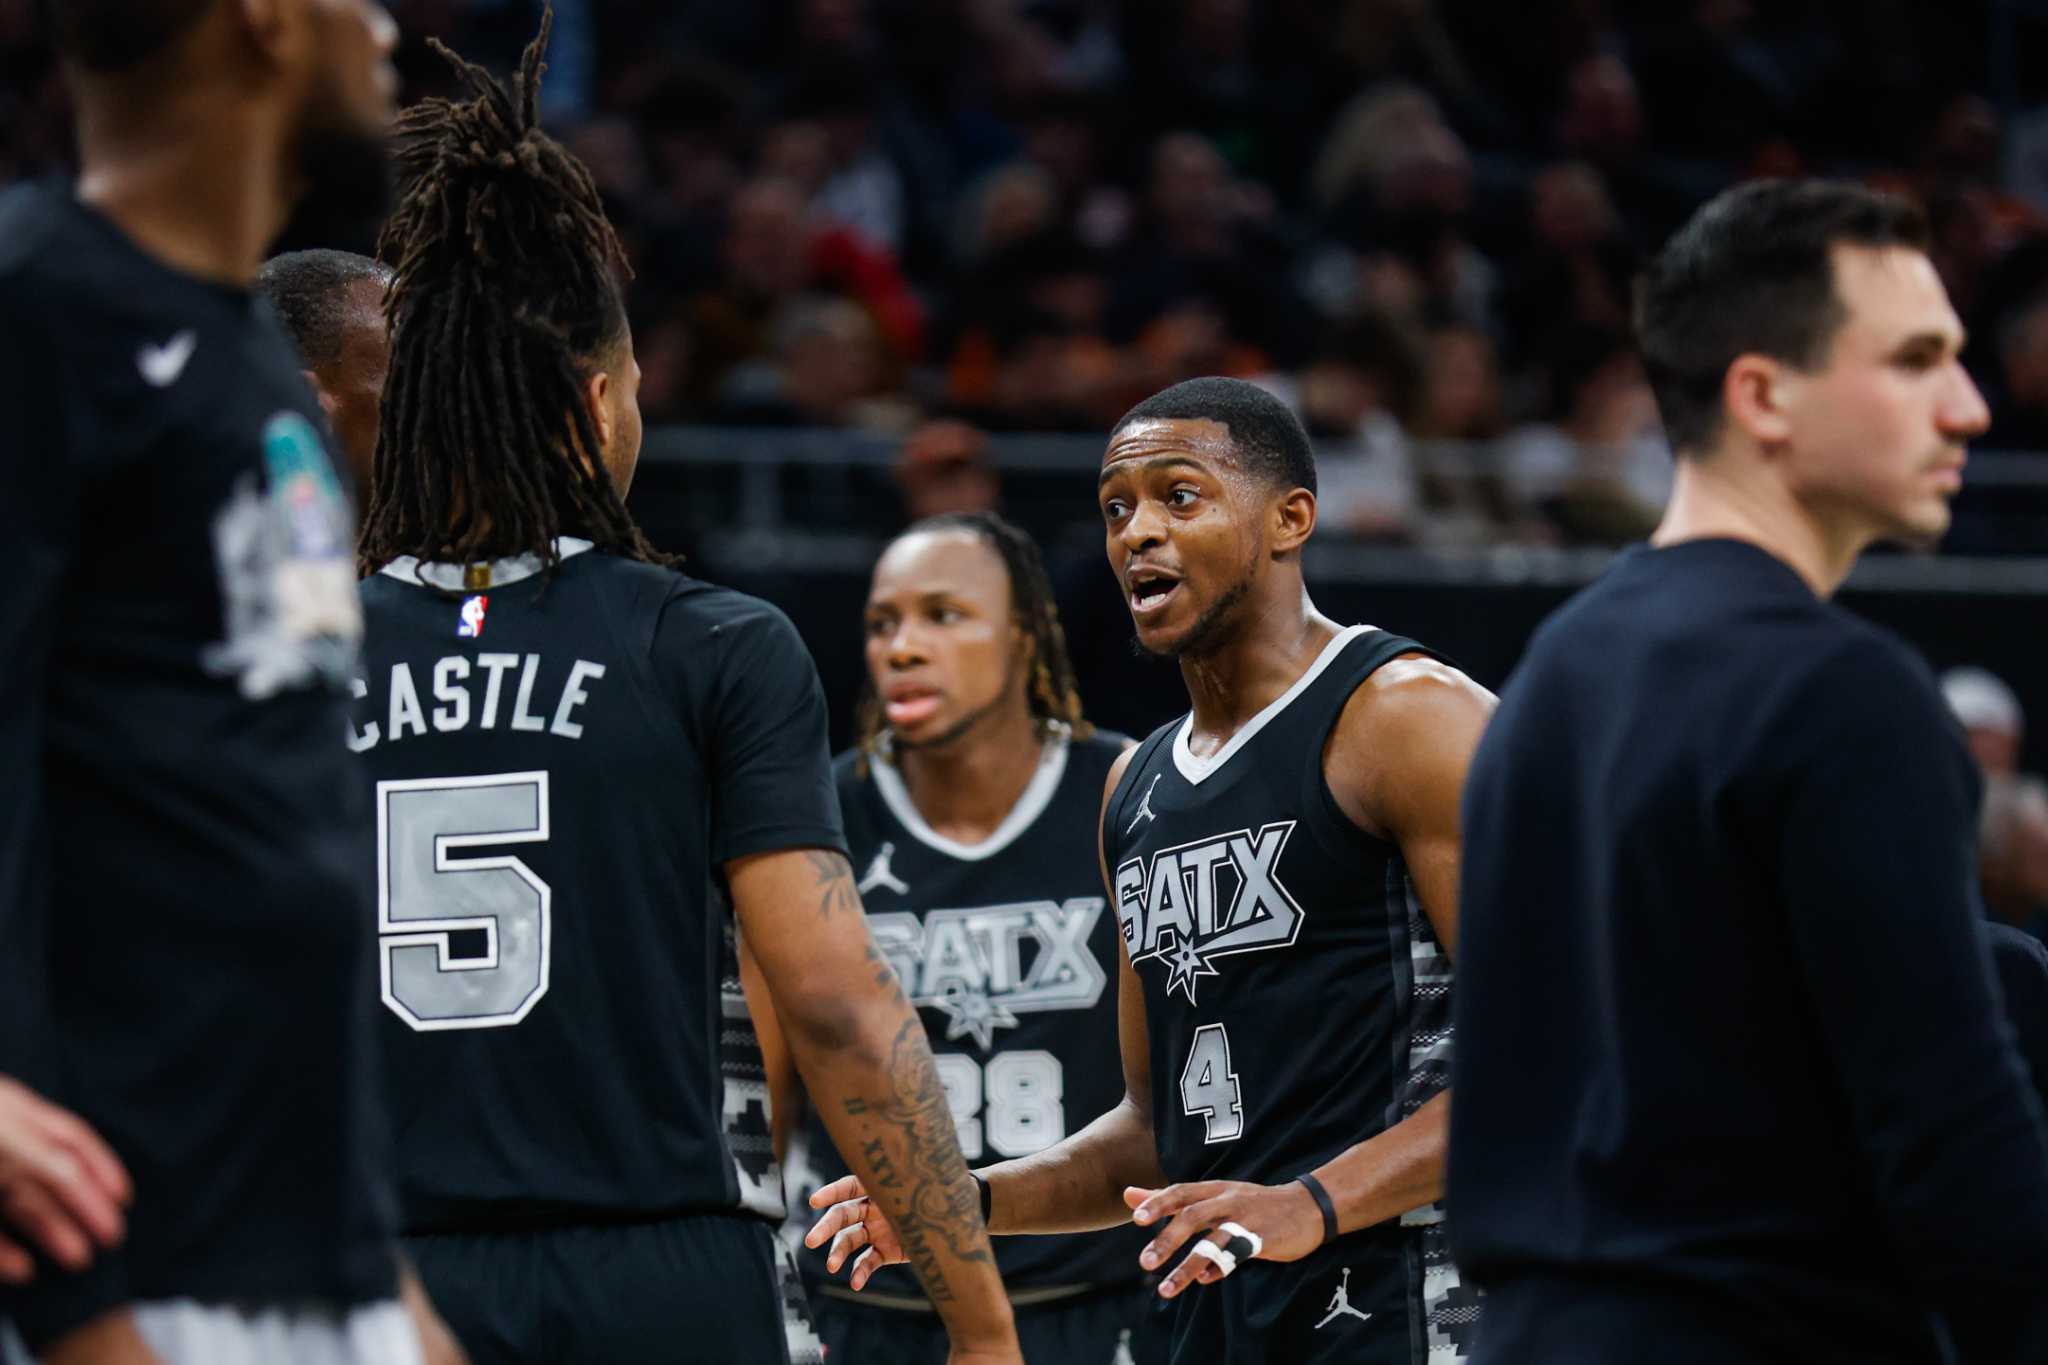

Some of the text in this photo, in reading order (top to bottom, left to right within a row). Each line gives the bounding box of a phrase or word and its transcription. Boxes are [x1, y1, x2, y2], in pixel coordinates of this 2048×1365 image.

[377, 770, 551, 1031] 5
[864, 897, 1107, 1013] SATX
[1116, 820, 1304, 968] SATX
[1180, 1022, 1244, 1144] 4
